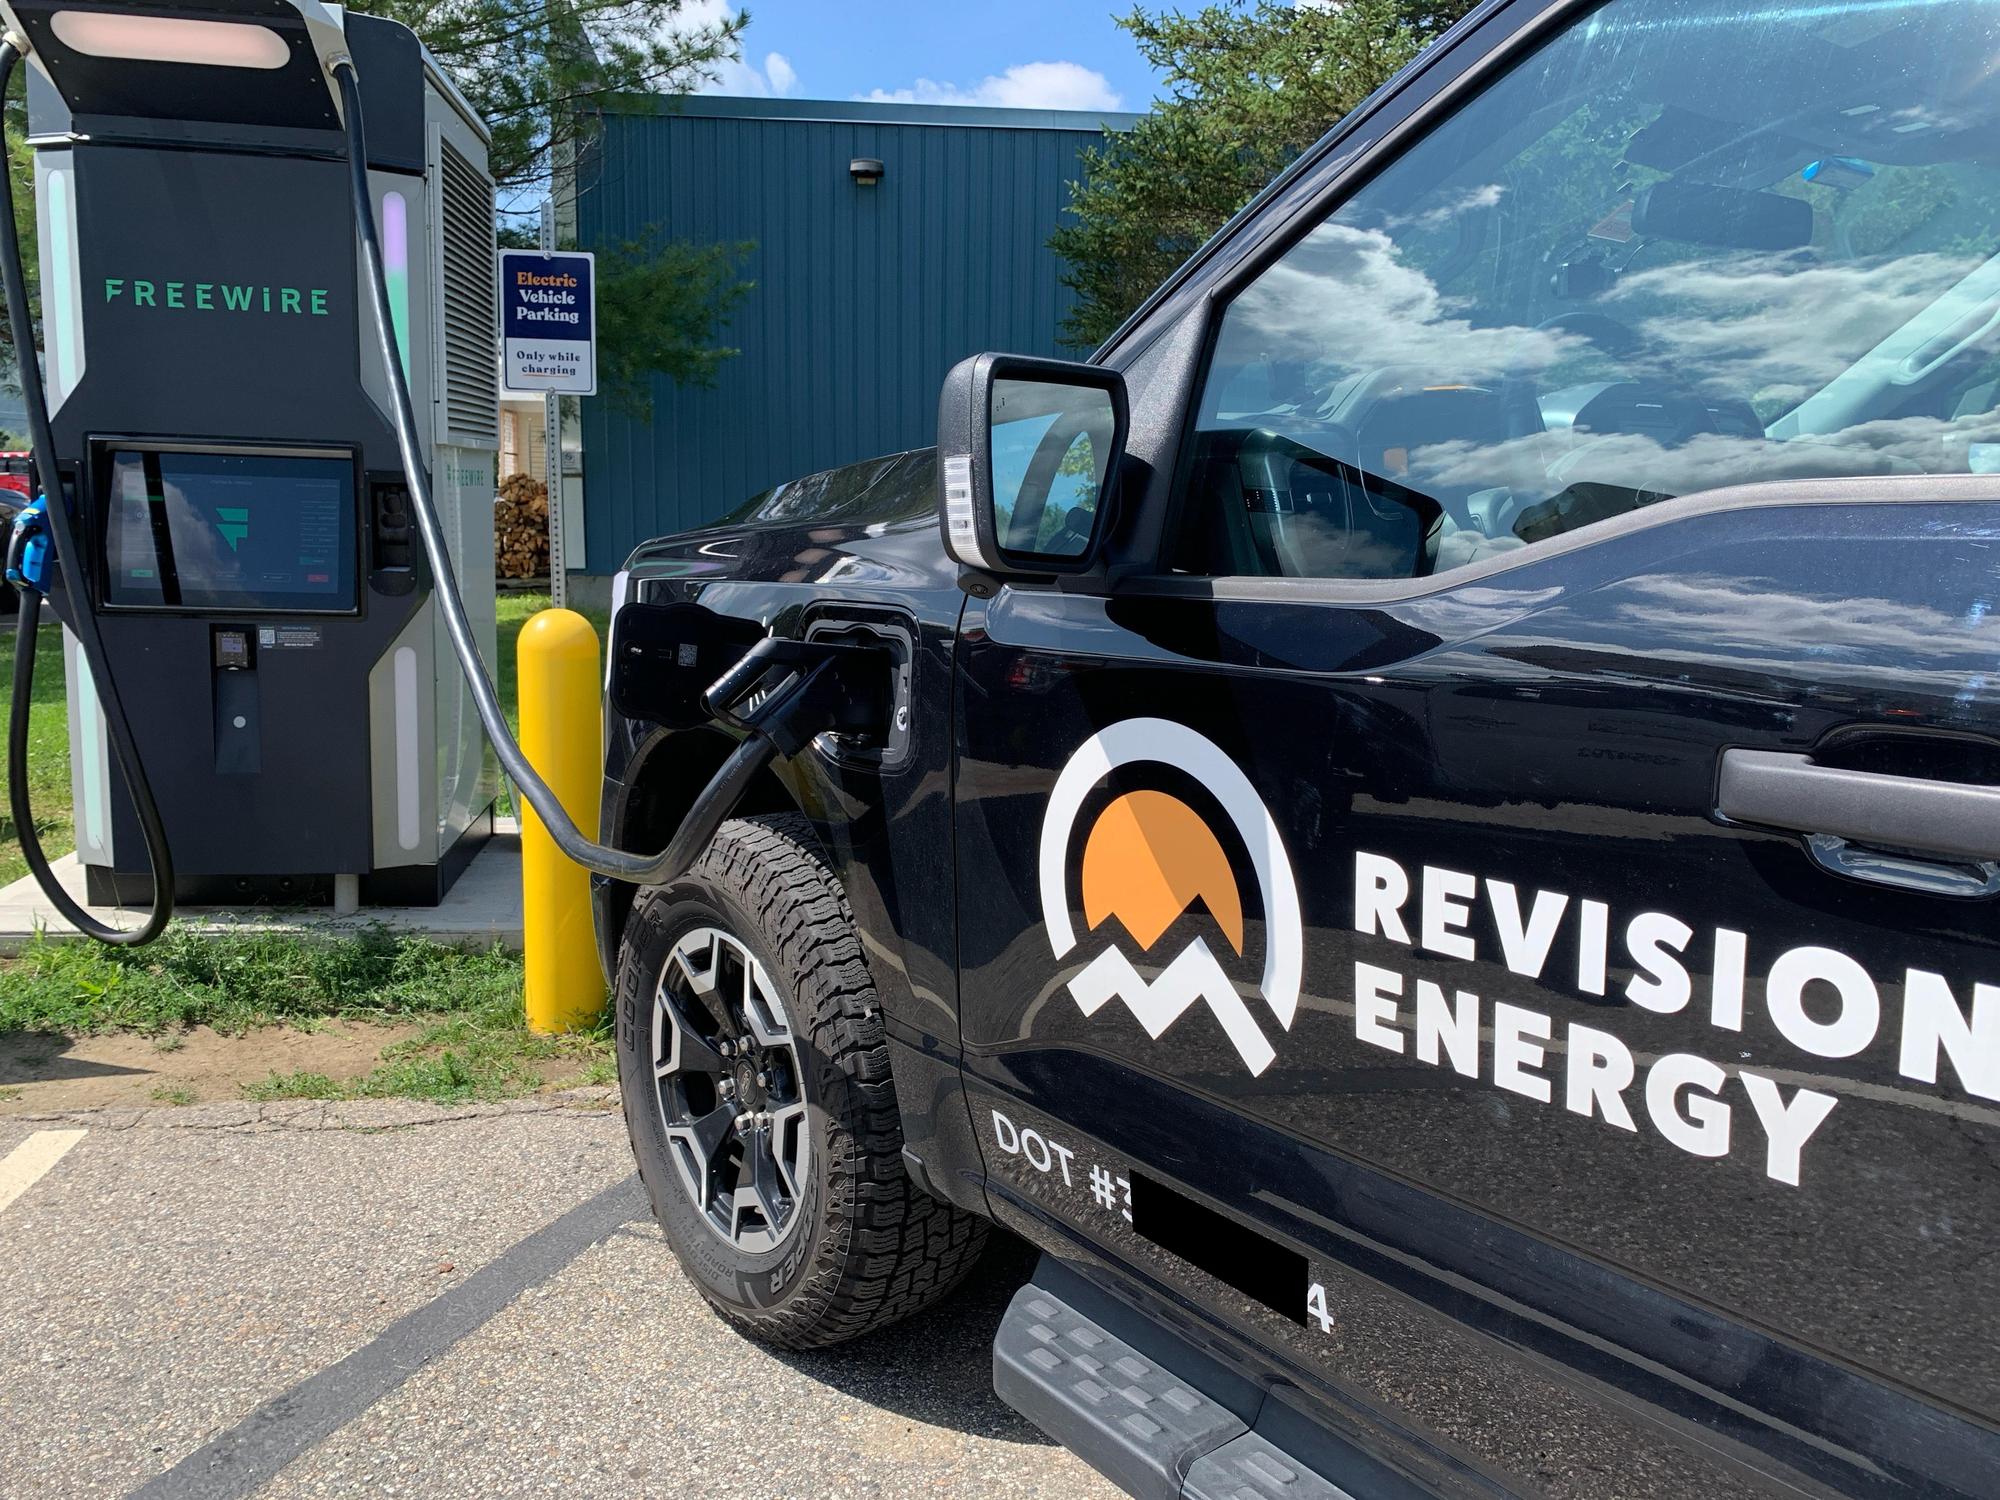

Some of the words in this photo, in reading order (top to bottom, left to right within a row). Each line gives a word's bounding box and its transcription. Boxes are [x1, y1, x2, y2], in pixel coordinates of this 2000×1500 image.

[516, 271, 577, 287] Electric
[105, 278, 329, 315] FREEWIRE
[519, 289, 576, 305] Vehicle
[516, 306, 579, 324] Parking
[516, 350, 545, 362] Only
[548, 352, 581, 362] while
[521, 364, 576, 376] charging
[1355, 850, 2000, 1102] REVISION
[1355, 961, 1839, 1187] ENERGY
[992, 1109, 1075, 1188] DOT
